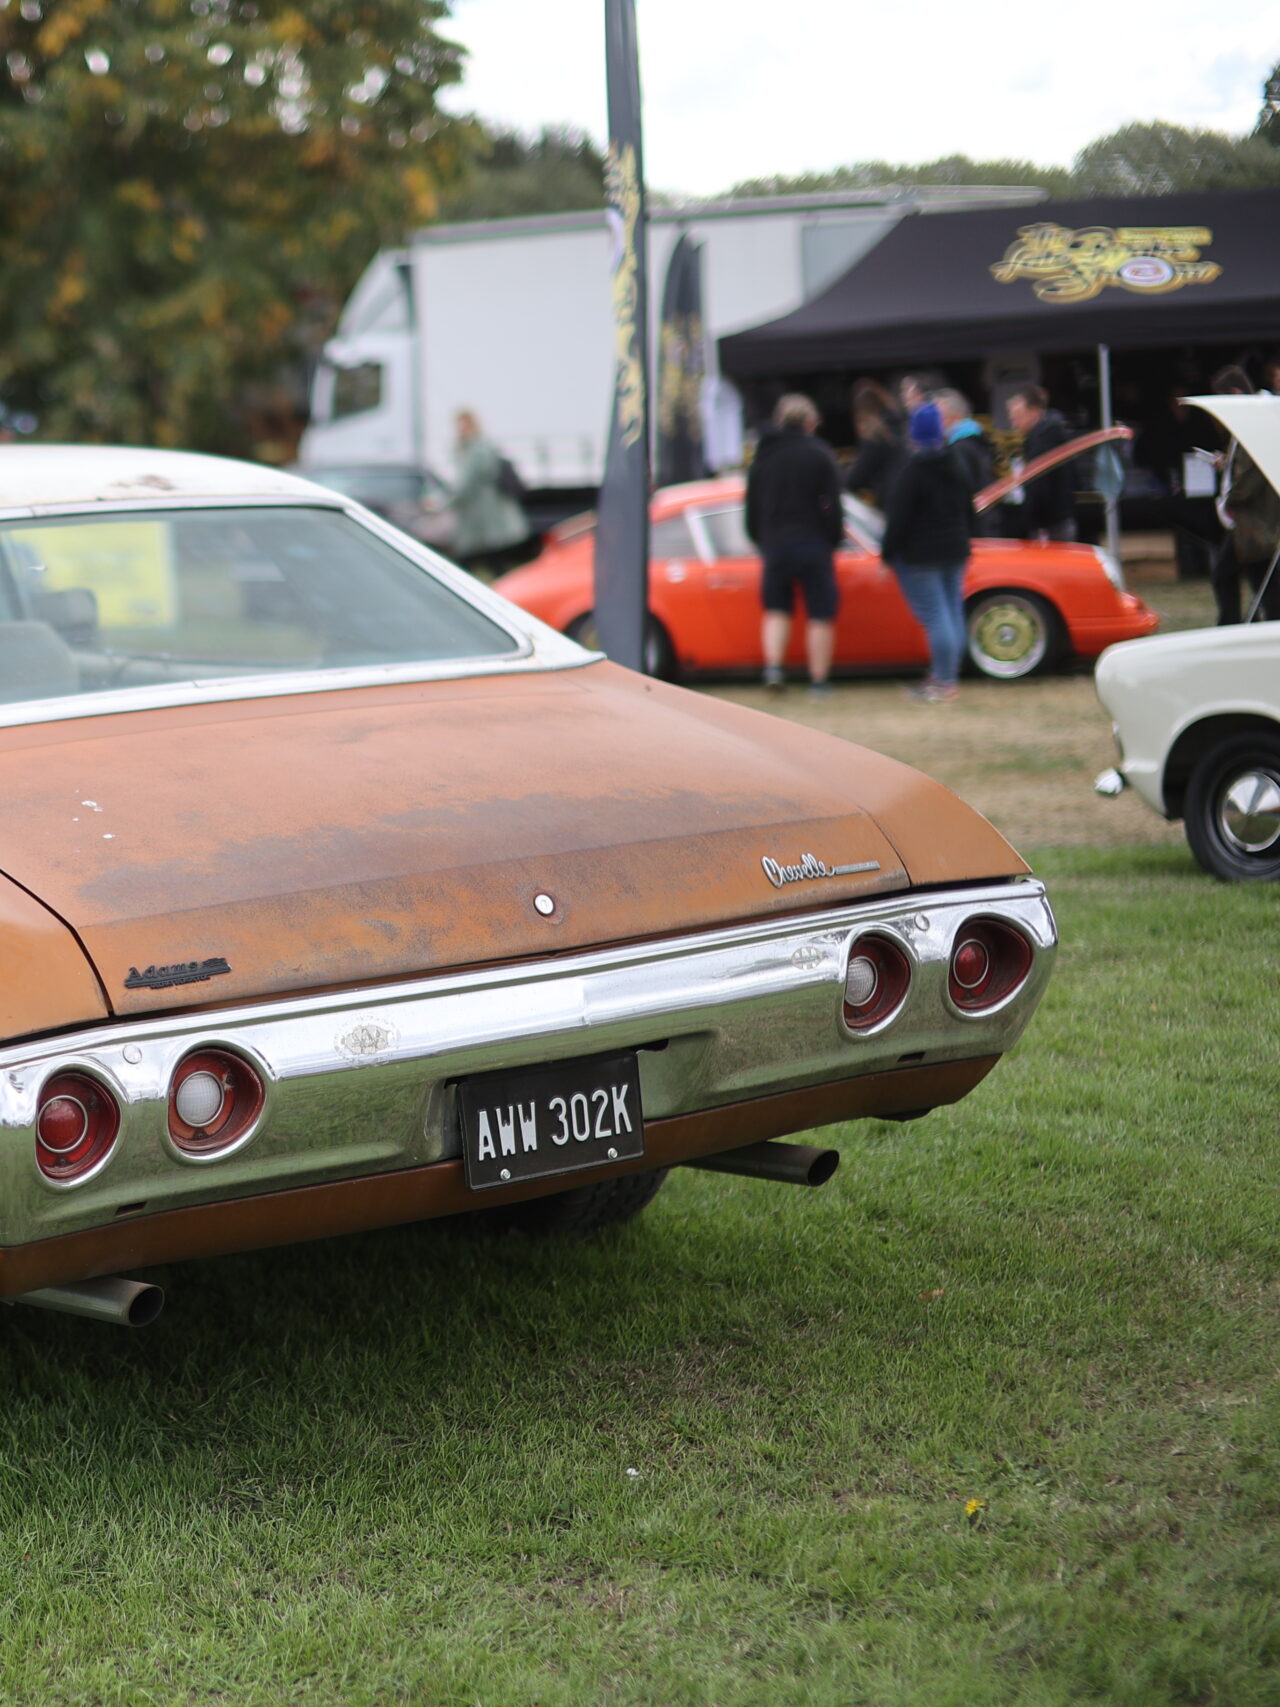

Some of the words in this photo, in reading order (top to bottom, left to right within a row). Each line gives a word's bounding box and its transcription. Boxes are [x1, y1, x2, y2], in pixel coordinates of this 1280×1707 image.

[761, 852, 835, 889] Chevelle
[478, 1101, 538, 1161] AWW
[549, 1084, 633, 1146] 302K
